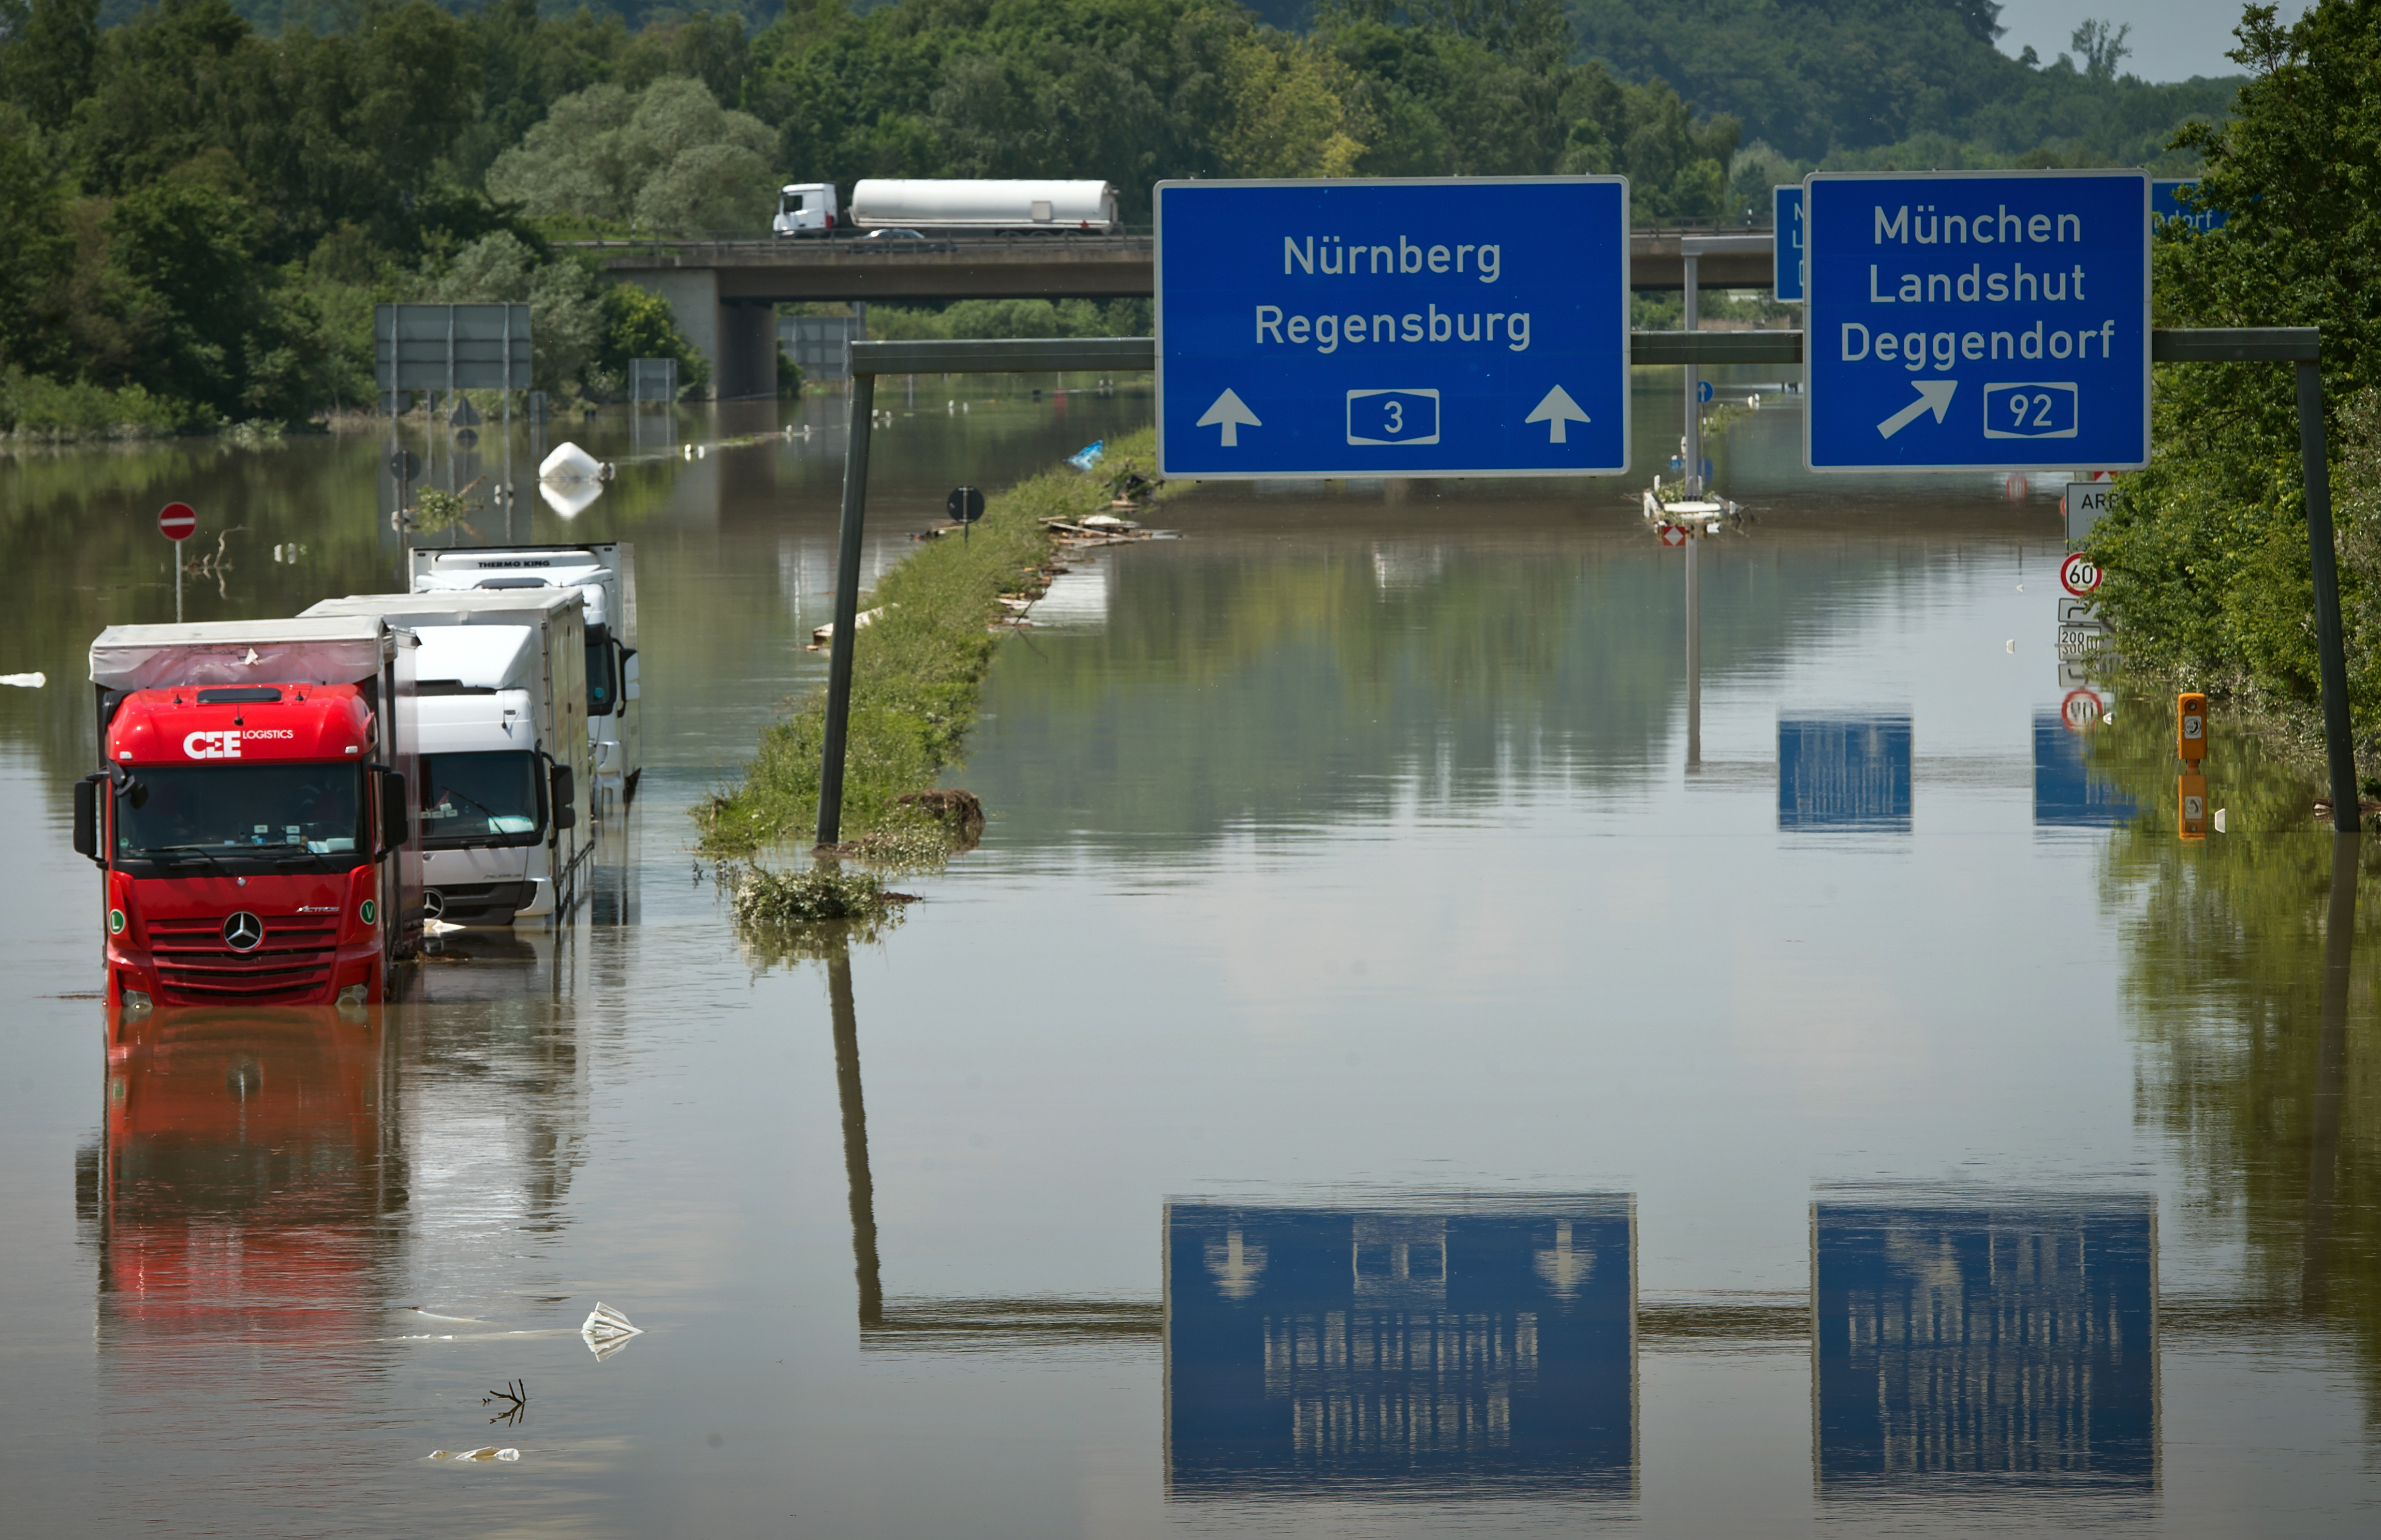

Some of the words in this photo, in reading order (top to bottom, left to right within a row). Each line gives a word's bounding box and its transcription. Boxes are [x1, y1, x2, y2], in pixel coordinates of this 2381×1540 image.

[1875, 204, 2080, 244] München
[1284, 235, 1500, 283] Nürnberg
[1870, 263, 2085, 302] Landshut
[1256, 304, 1530, 354] Regensburg
[1842, 320, 2114, 371] Deggendorf
[1384, 401, 1403, 433] 3
[2010, 394, 2052, 426] 92
[2069, 565, 2093, 584] 60
[183, 731, 241, 759] CEE
[242, 730, 293, 739] LOGISTICS
[112, 915, 120, 929] L
[365, 905, 373, 919] V
